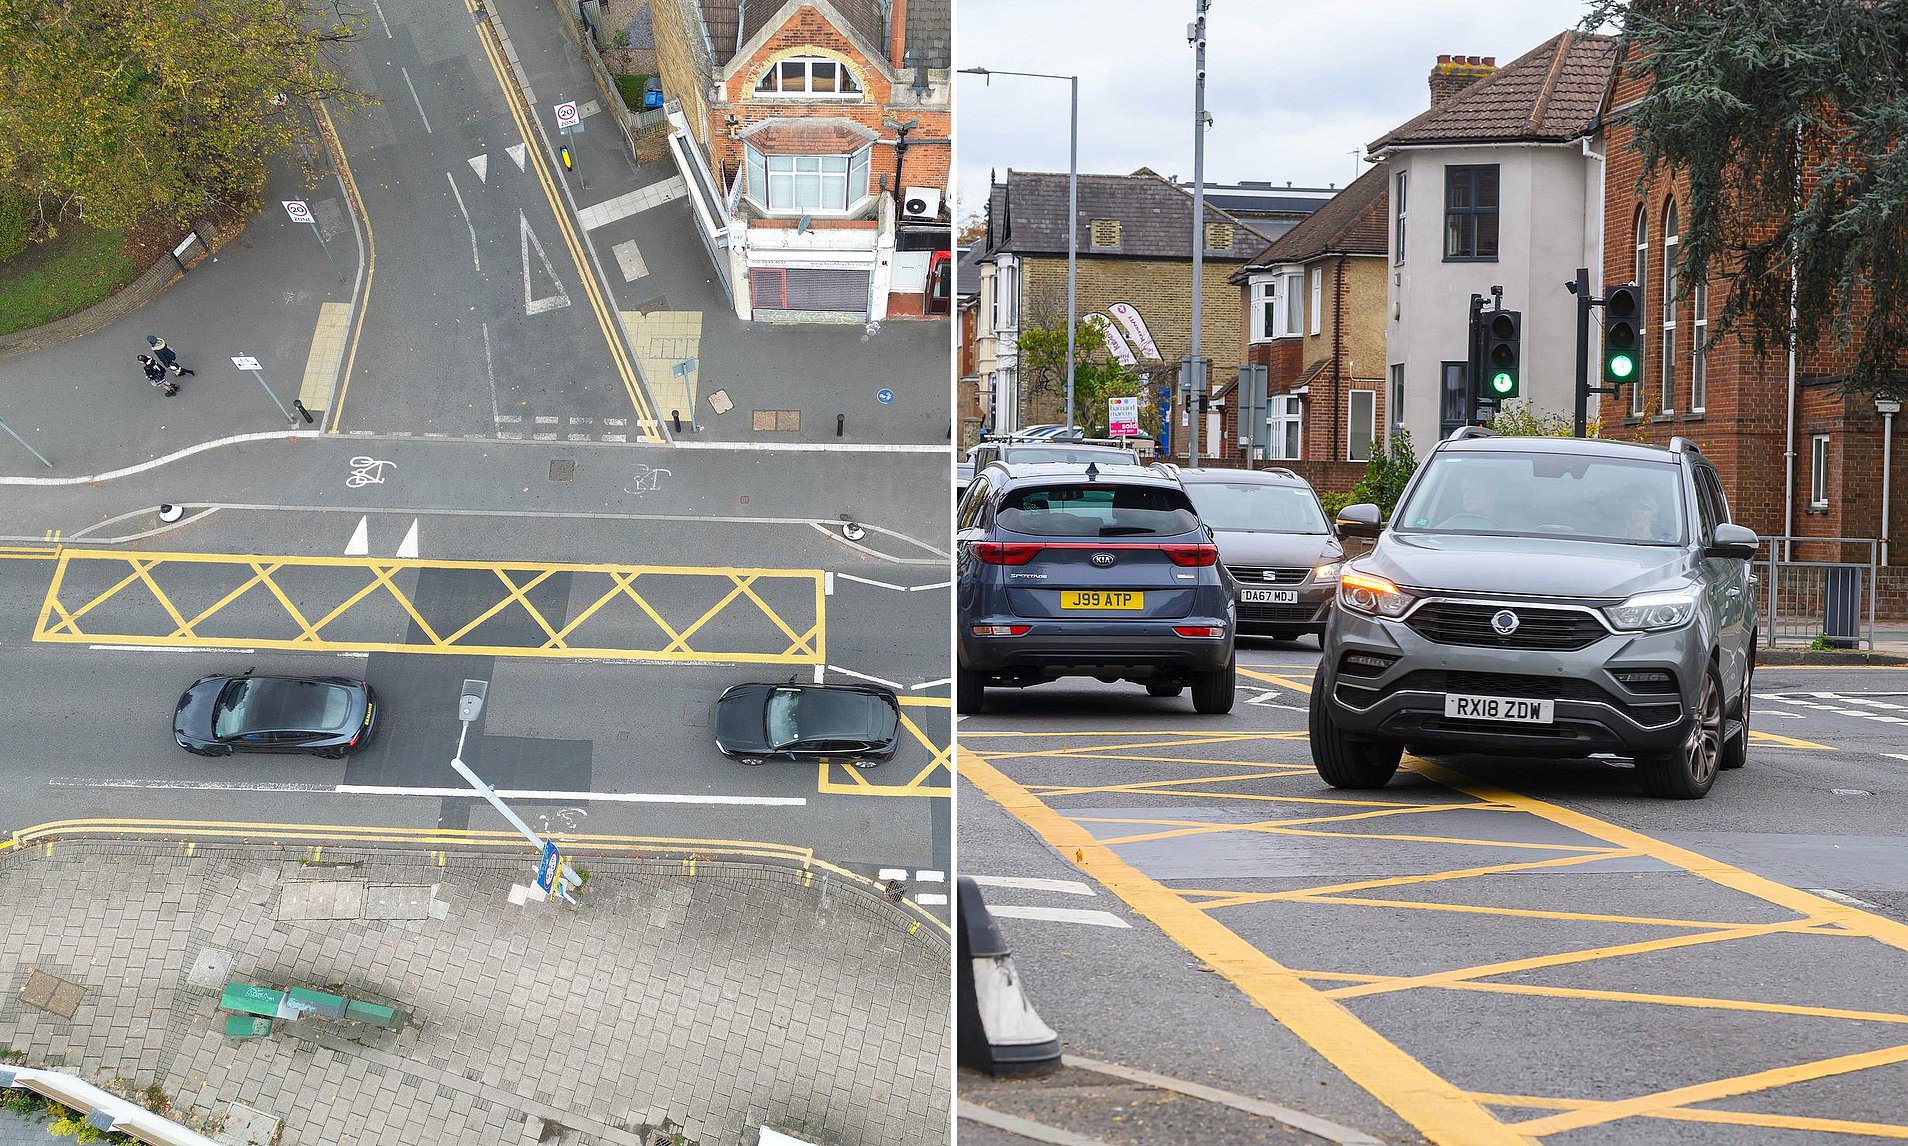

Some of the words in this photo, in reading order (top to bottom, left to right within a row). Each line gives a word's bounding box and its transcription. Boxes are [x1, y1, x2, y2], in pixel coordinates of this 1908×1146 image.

[560, 108, 573, 117] 20
[1121, 422, 1137, 430] sold
[1095, 555, 1111, 564] KIA
[1072, 592, 1100, 606] J99
[1104, 592, 1132, 606] ATP
[1245, 590, 1272, 601] DA67
[1274, 591, 1294, 602] MDJ
[1457, 697, 1499, 717] RX18
[1504, 700, 1541, 720] ZDW
